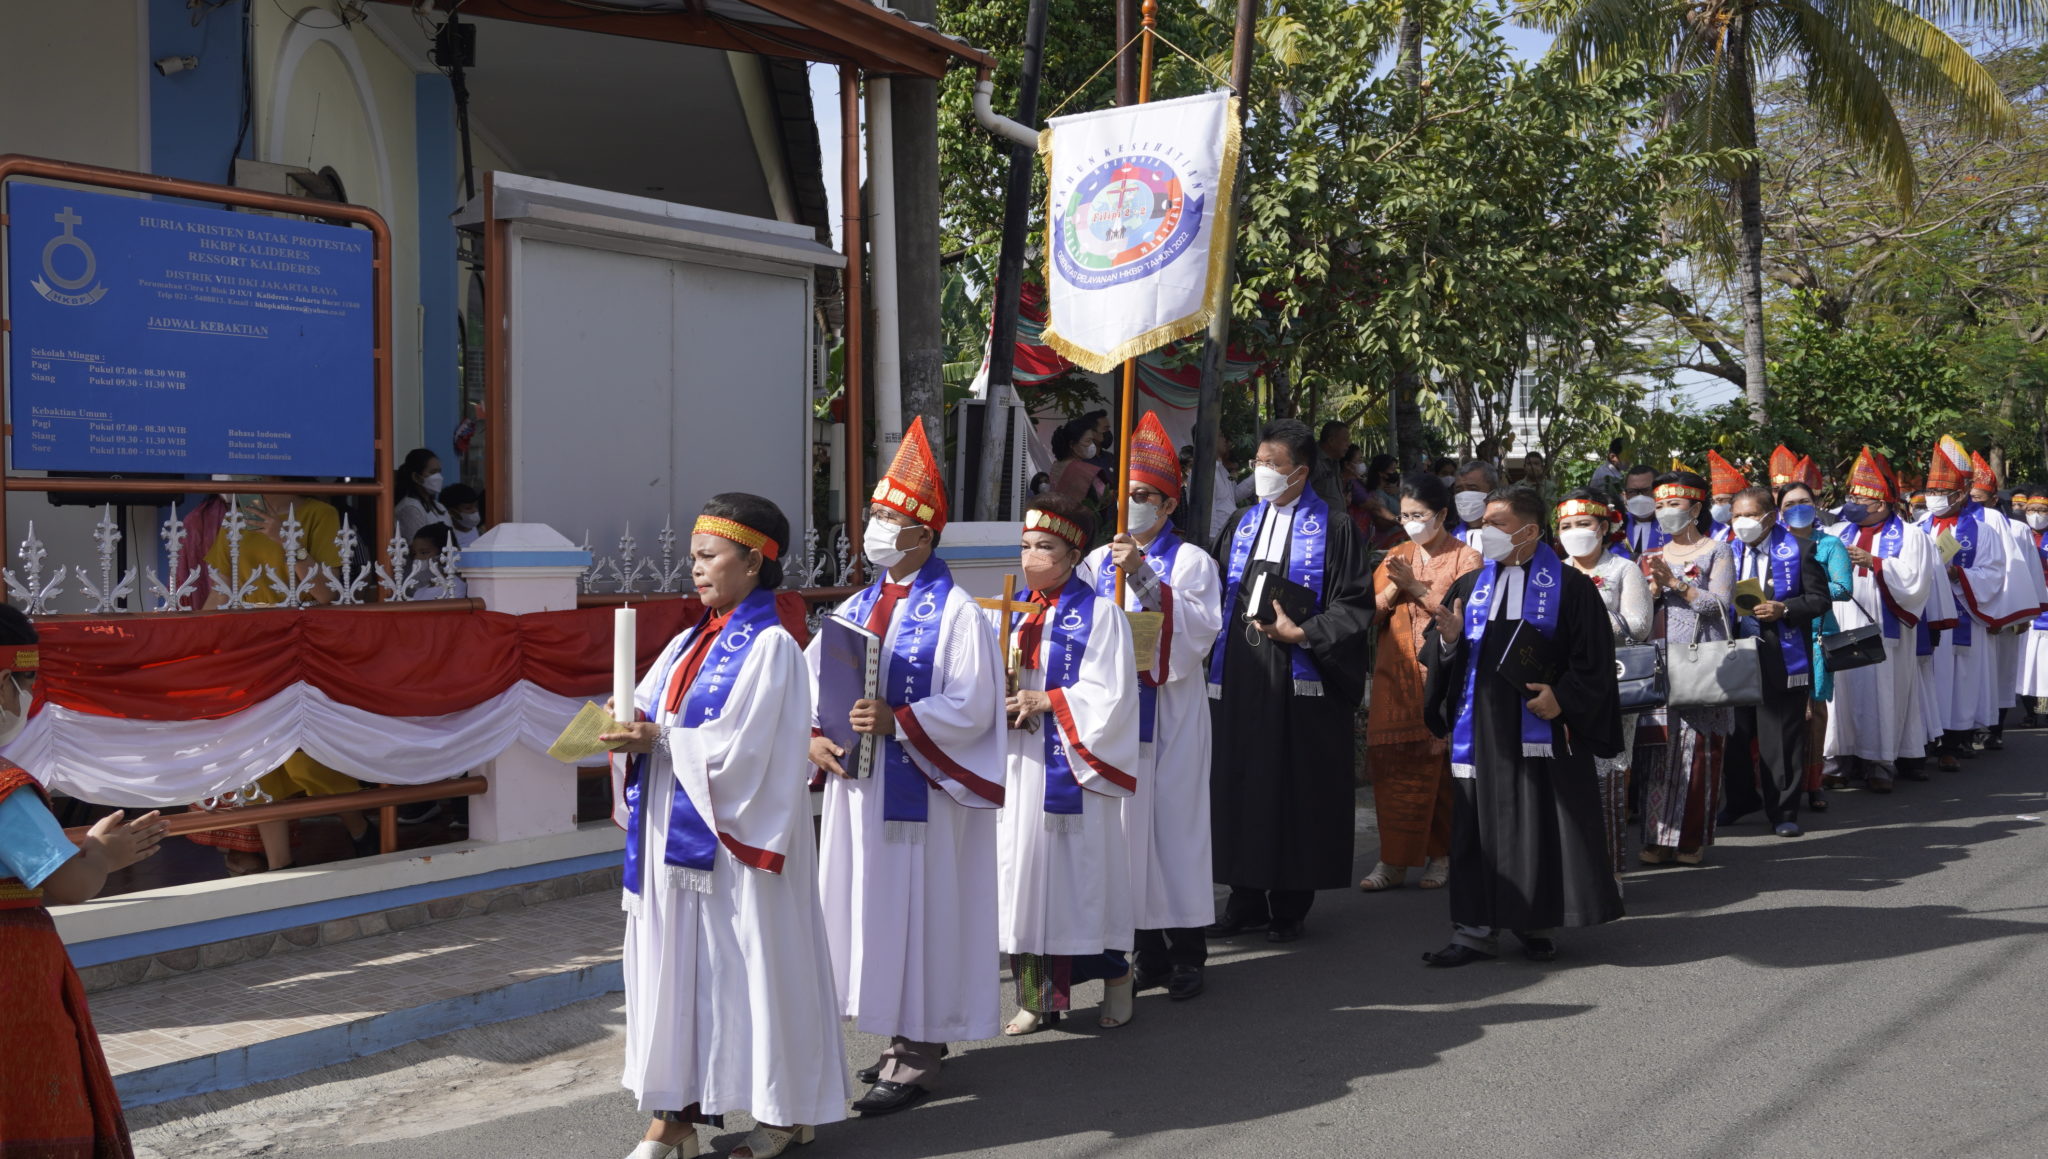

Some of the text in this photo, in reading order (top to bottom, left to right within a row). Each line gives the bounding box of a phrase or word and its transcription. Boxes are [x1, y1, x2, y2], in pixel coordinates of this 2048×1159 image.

[1055, 157, 1096, 208] TAHUN
[1092, 211, 1121, 223] Filipi
[139, 216, 362, 253] HURIA KRISTEN BATAK PROTESTAN
[200, 238, 311, 261] HKBP KALIDERES
[1119, 266, 1144, 279] HKBP
[1145, 248, 1174, 270] TAHUN
[1171, 231, 1190, 251] 2022
[188, 251, 321, 276] RESSORT KALIDERES
[139, 279, 183, 289] Perumahan
[229, 288, 236, 296] D
[256, 291, 289, 301] Kalideres
[294, 295, 320, 305] Jakarta
[165, 269, 338, 296] DISTRIK VIII DKI JAKARTA RAYA
[53, 293, 86, 304] HKBP
[147, 316, 269, 335] JADWAL KEBAKTIAN
[31, 348, 65, 358] Sekolah
[67, 350, 100, 361] Minggu
[31, 360, 51, 370] Pagi
[89, 364, 114, 374] Pukul
[115, 366, 137, 376] 07.00
[167, 369, 186, 379] WIB
[31, 373, 56, 384] Siang
[89, 376, 114, 386] Pukul
[145, 380, 165, 389] 11.30
[167, 382, 186, 390] WIB
[32, 406, 76, 417] Kebaktian
[79, 409, 107, 418] Umum
[32, 419, 51, 429] Pagi
[89, 422, 114, 432] Pukul
[116, 424, 138, 432] 07.00
[167, 426, 187, 434] WIB
[228, 429, 255, 437] Bahasa
[257, 430, 292, 438] Indonesia
[32, 431, 56, 442] Siang
[89, 434, 114, 443] Pukul
[145, 437, 166, 445] 11.30
[167, 437, 187, 446] WIB
[228, 440, 255, 448] Bahasa
[32, 444, 52, 452] Sore
[89, 446, 114, 455] Pukul
[167, 449, 187, 457] WIB
[228, 451, 255, 459] Bahasa
[257, 452, 293, 460] Indonesia
[1304, 539, 1313, 566] HKBP
[1784, 561, 1792, 591] PESTA
[1537, 591, 1547, 620] HKBP
[908, 627, 923, 664] HKBP
[1062, 634, 1074, 681] PESTA
[708, 656, 731, 694] HKBP
